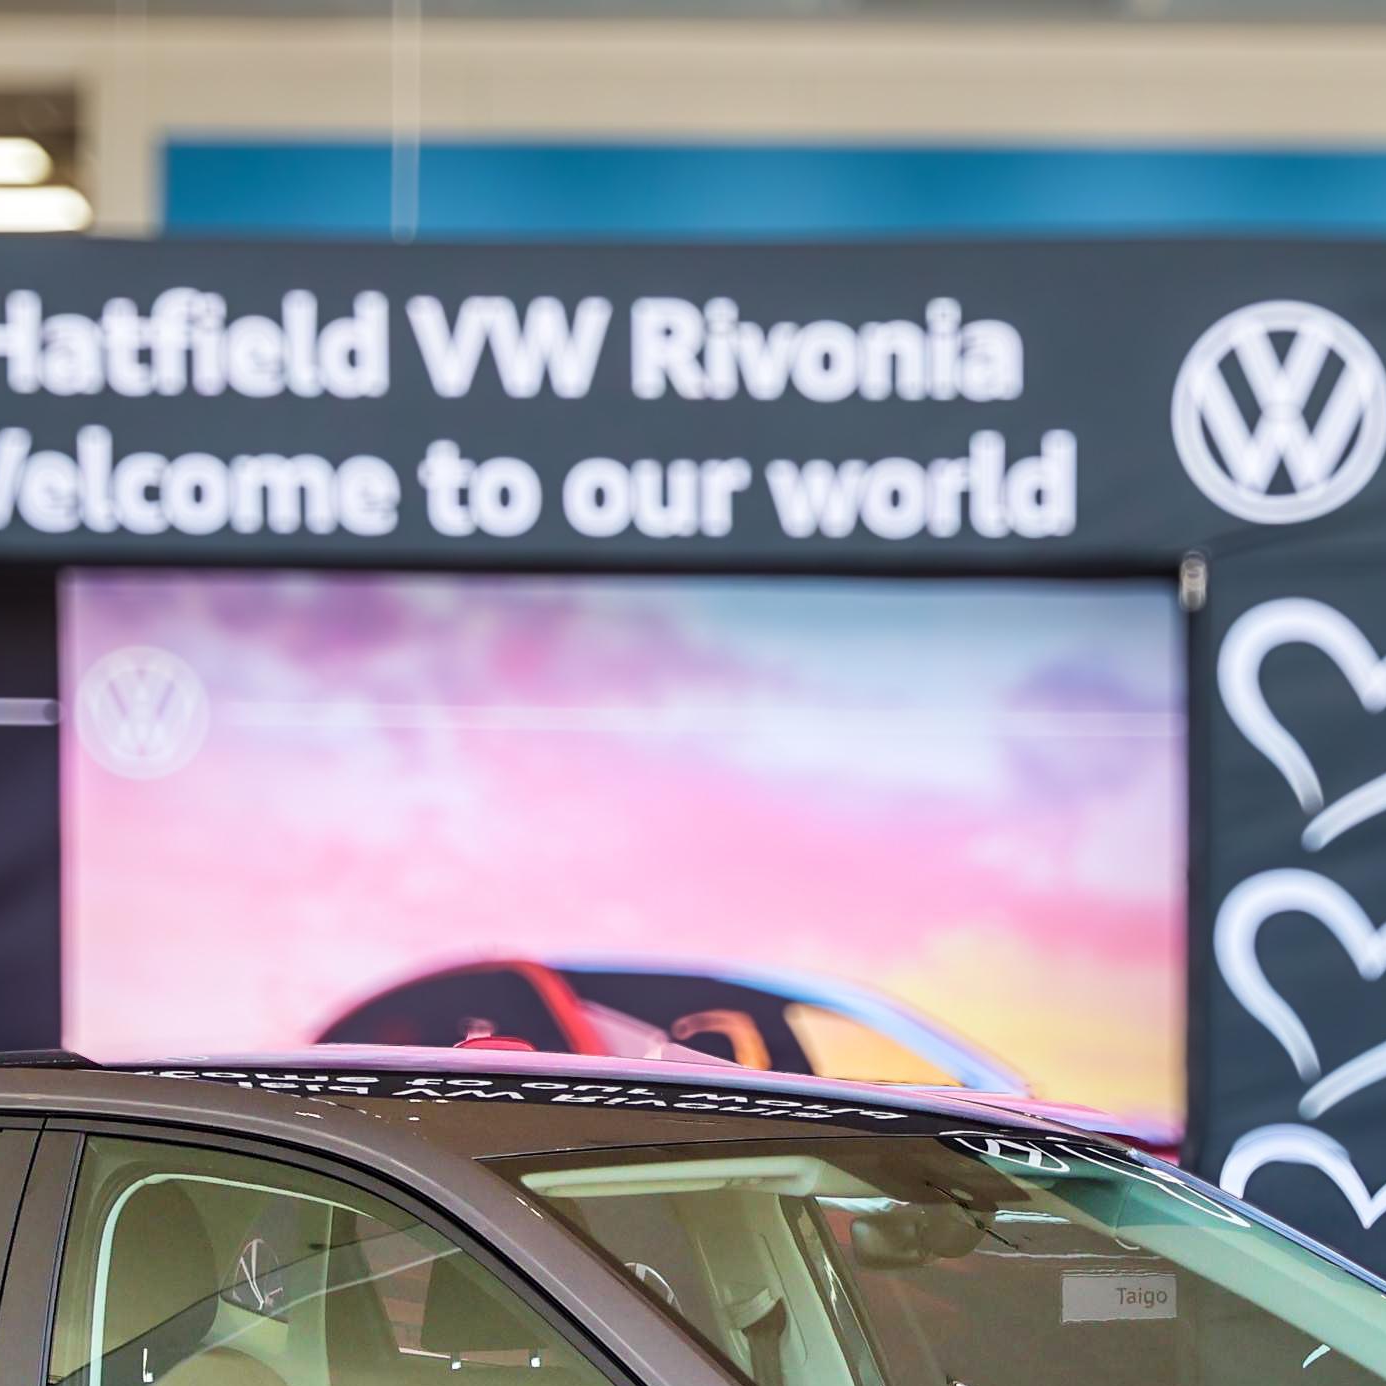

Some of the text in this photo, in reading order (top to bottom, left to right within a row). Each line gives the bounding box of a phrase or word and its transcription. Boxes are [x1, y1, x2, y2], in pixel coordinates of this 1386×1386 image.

[406, 294, 613, 400] VW
[630, 296, 1024, 403] Rivonia
[417, 438, 542, 538] to
[562, 456, 753, 539] our
[765, 429, 1078, 540] world
[1114, 1286, 1169, 1309] Taigo
